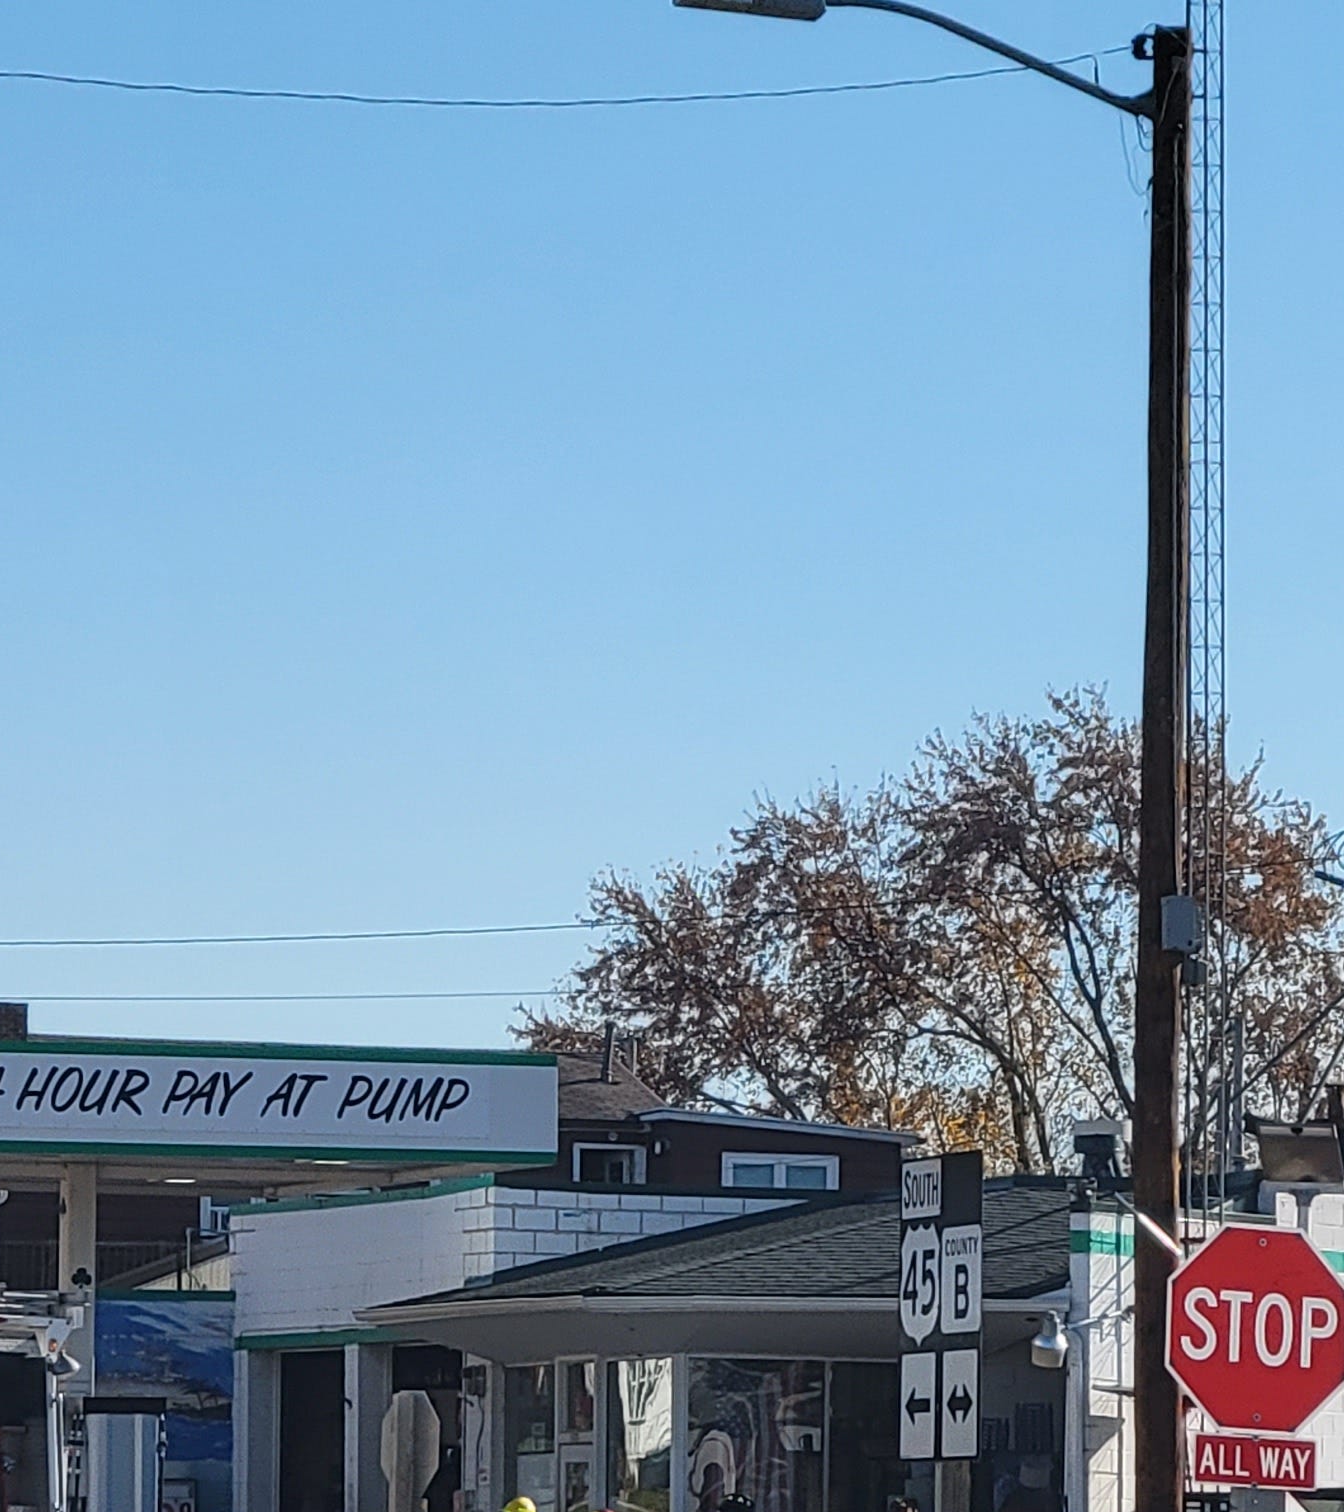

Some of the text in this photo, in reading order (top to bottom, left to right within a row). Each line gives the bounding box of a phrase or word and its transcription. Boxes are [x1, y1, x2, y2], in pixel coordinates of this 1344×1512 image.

[16, 1067, 150, 1115] HOUR
[163, 1070, 253, 1116] PAY
[261, 1073, 328, 1118] AT
[338, 1075, 470, 1122] PUMP
[903, 1170, 939, 1208] SOUTH
[944, 1234, 979, 1257] COUNTY
[903, 1249, 936, 1317] 45
[954, 1264, 969, 1320] B
[1180, 1286, 1339, 1369] STOP
[1199, 1443, 1312, 1481] ALL WAY
